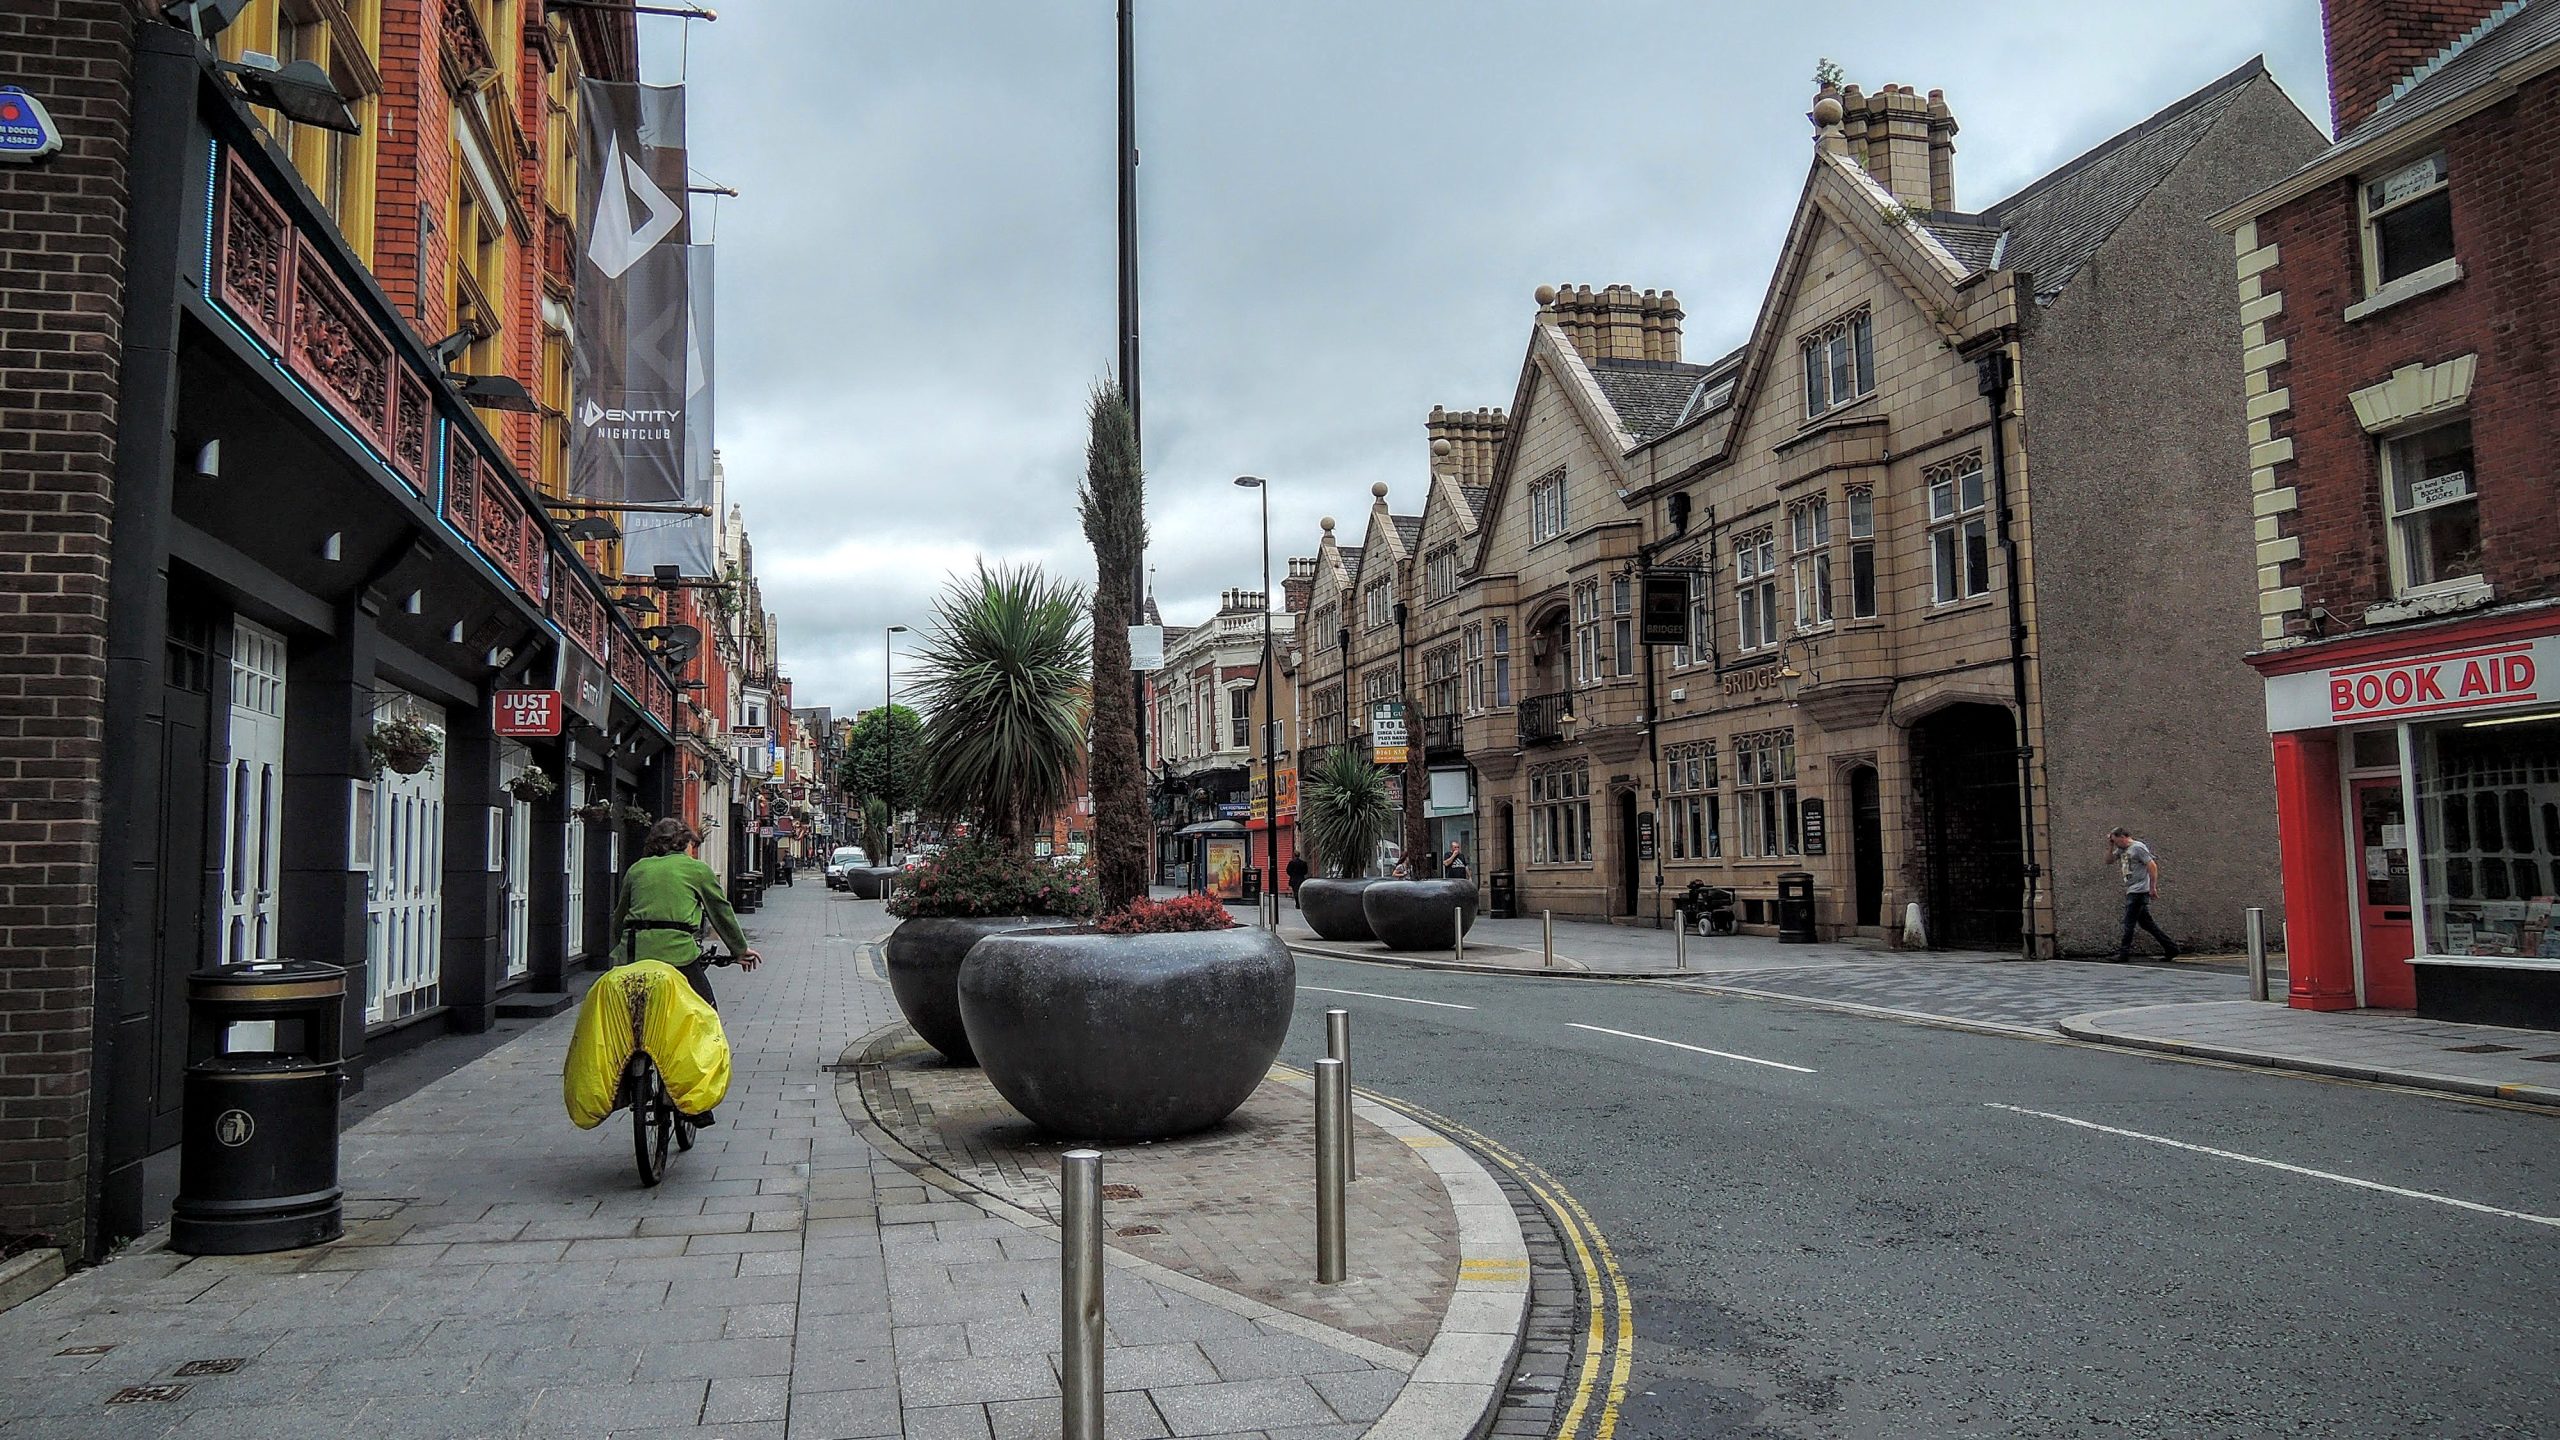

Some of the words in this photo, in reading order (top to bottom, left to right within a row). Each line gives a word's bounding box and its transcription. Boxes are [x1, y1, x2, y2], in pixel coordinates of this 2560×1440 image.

[8, 127, 38, 135] DOCTOR
[580, 397, 680, 427] IDENTITY
[598, 427, 671, 440] NIGHTCLUB
[2440, 472, 2464, 485] BOOKS
[2420, 485, 2444, 499] BOOKS
[1647, 624, 1684, 634] BRIDGES
[2330, 665, 2446, 712] BOOK
[2458, 654, 2536, 698] AID
[503, 694, 551, 710] JUST
[514, 711, 551, 726] EAT
[1378, 720, 1395, 729] TO
